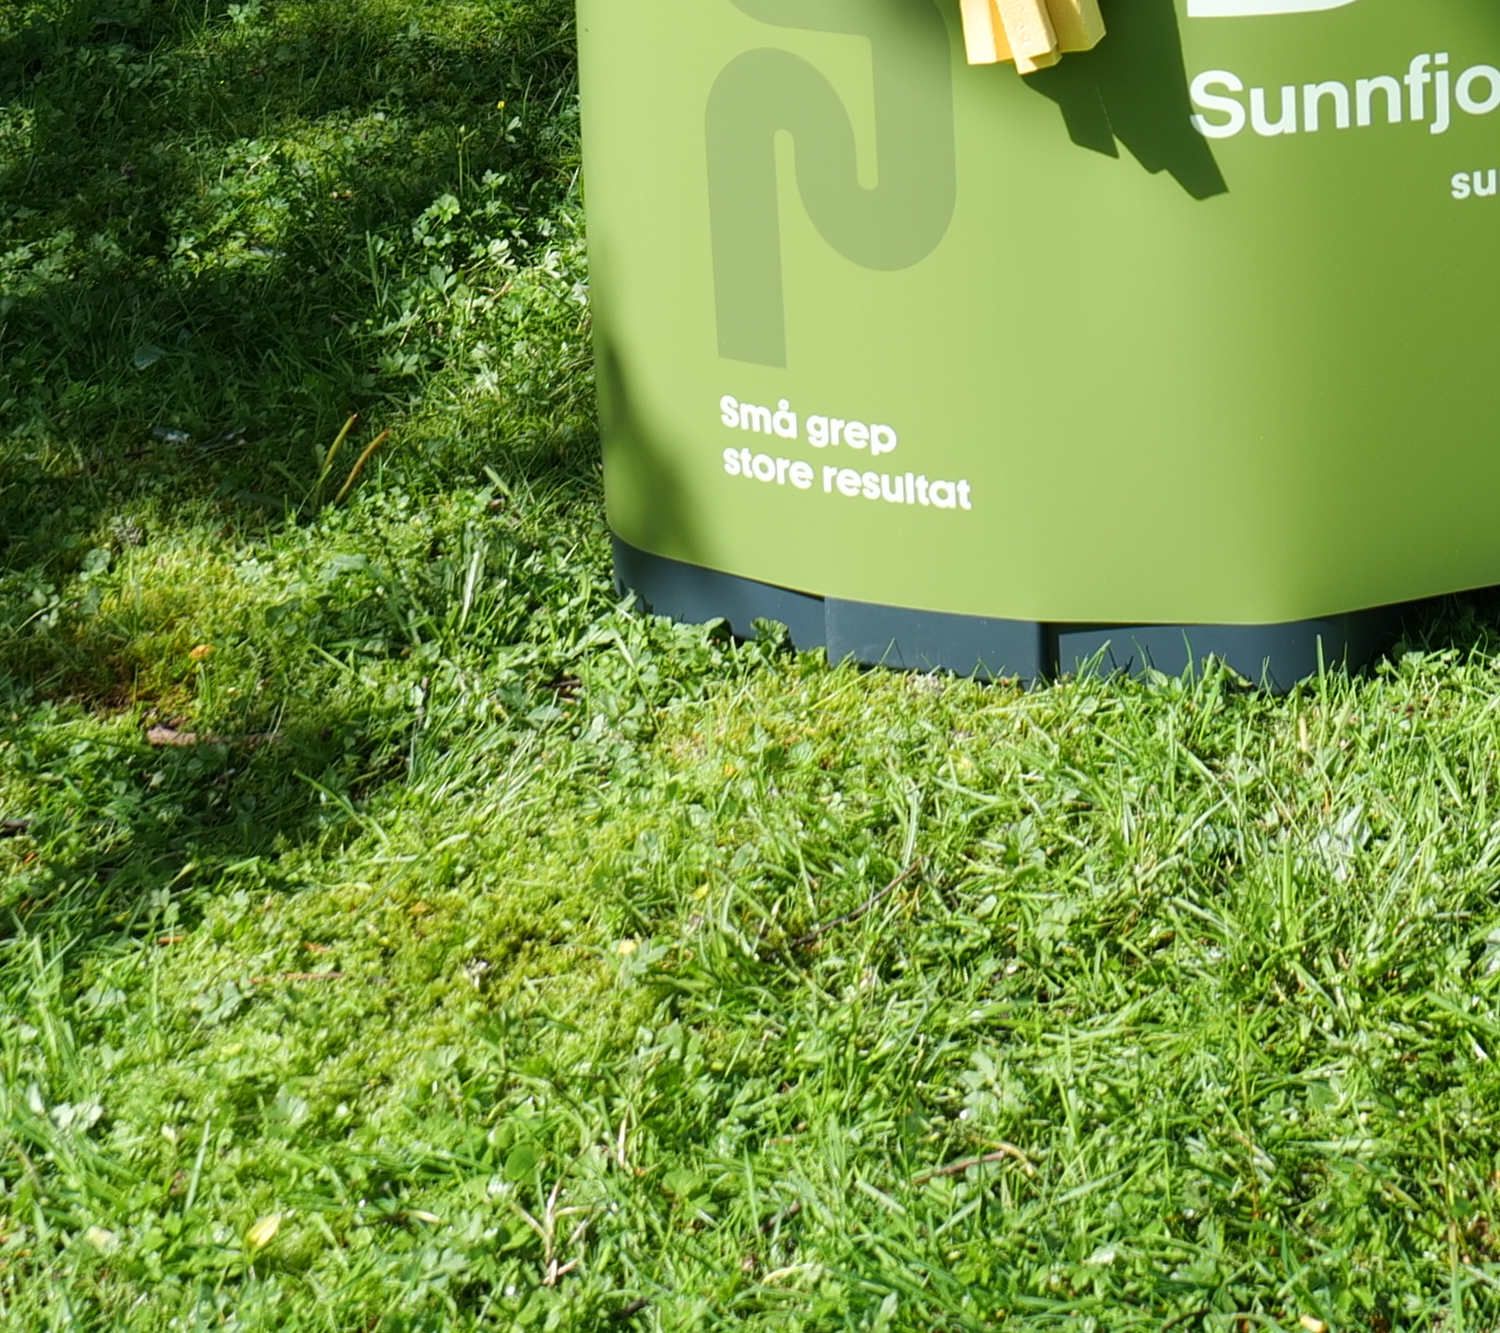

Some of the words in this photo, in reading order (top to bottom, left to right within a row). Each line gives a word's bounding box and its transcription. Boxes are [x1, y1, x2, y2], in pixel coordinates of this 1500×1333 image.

[720, 395, 798, 439] Små
[806, 414, 897, 456] grep
[723, 447, 814, 489] store
[823, 465, 972, 510] resultat
